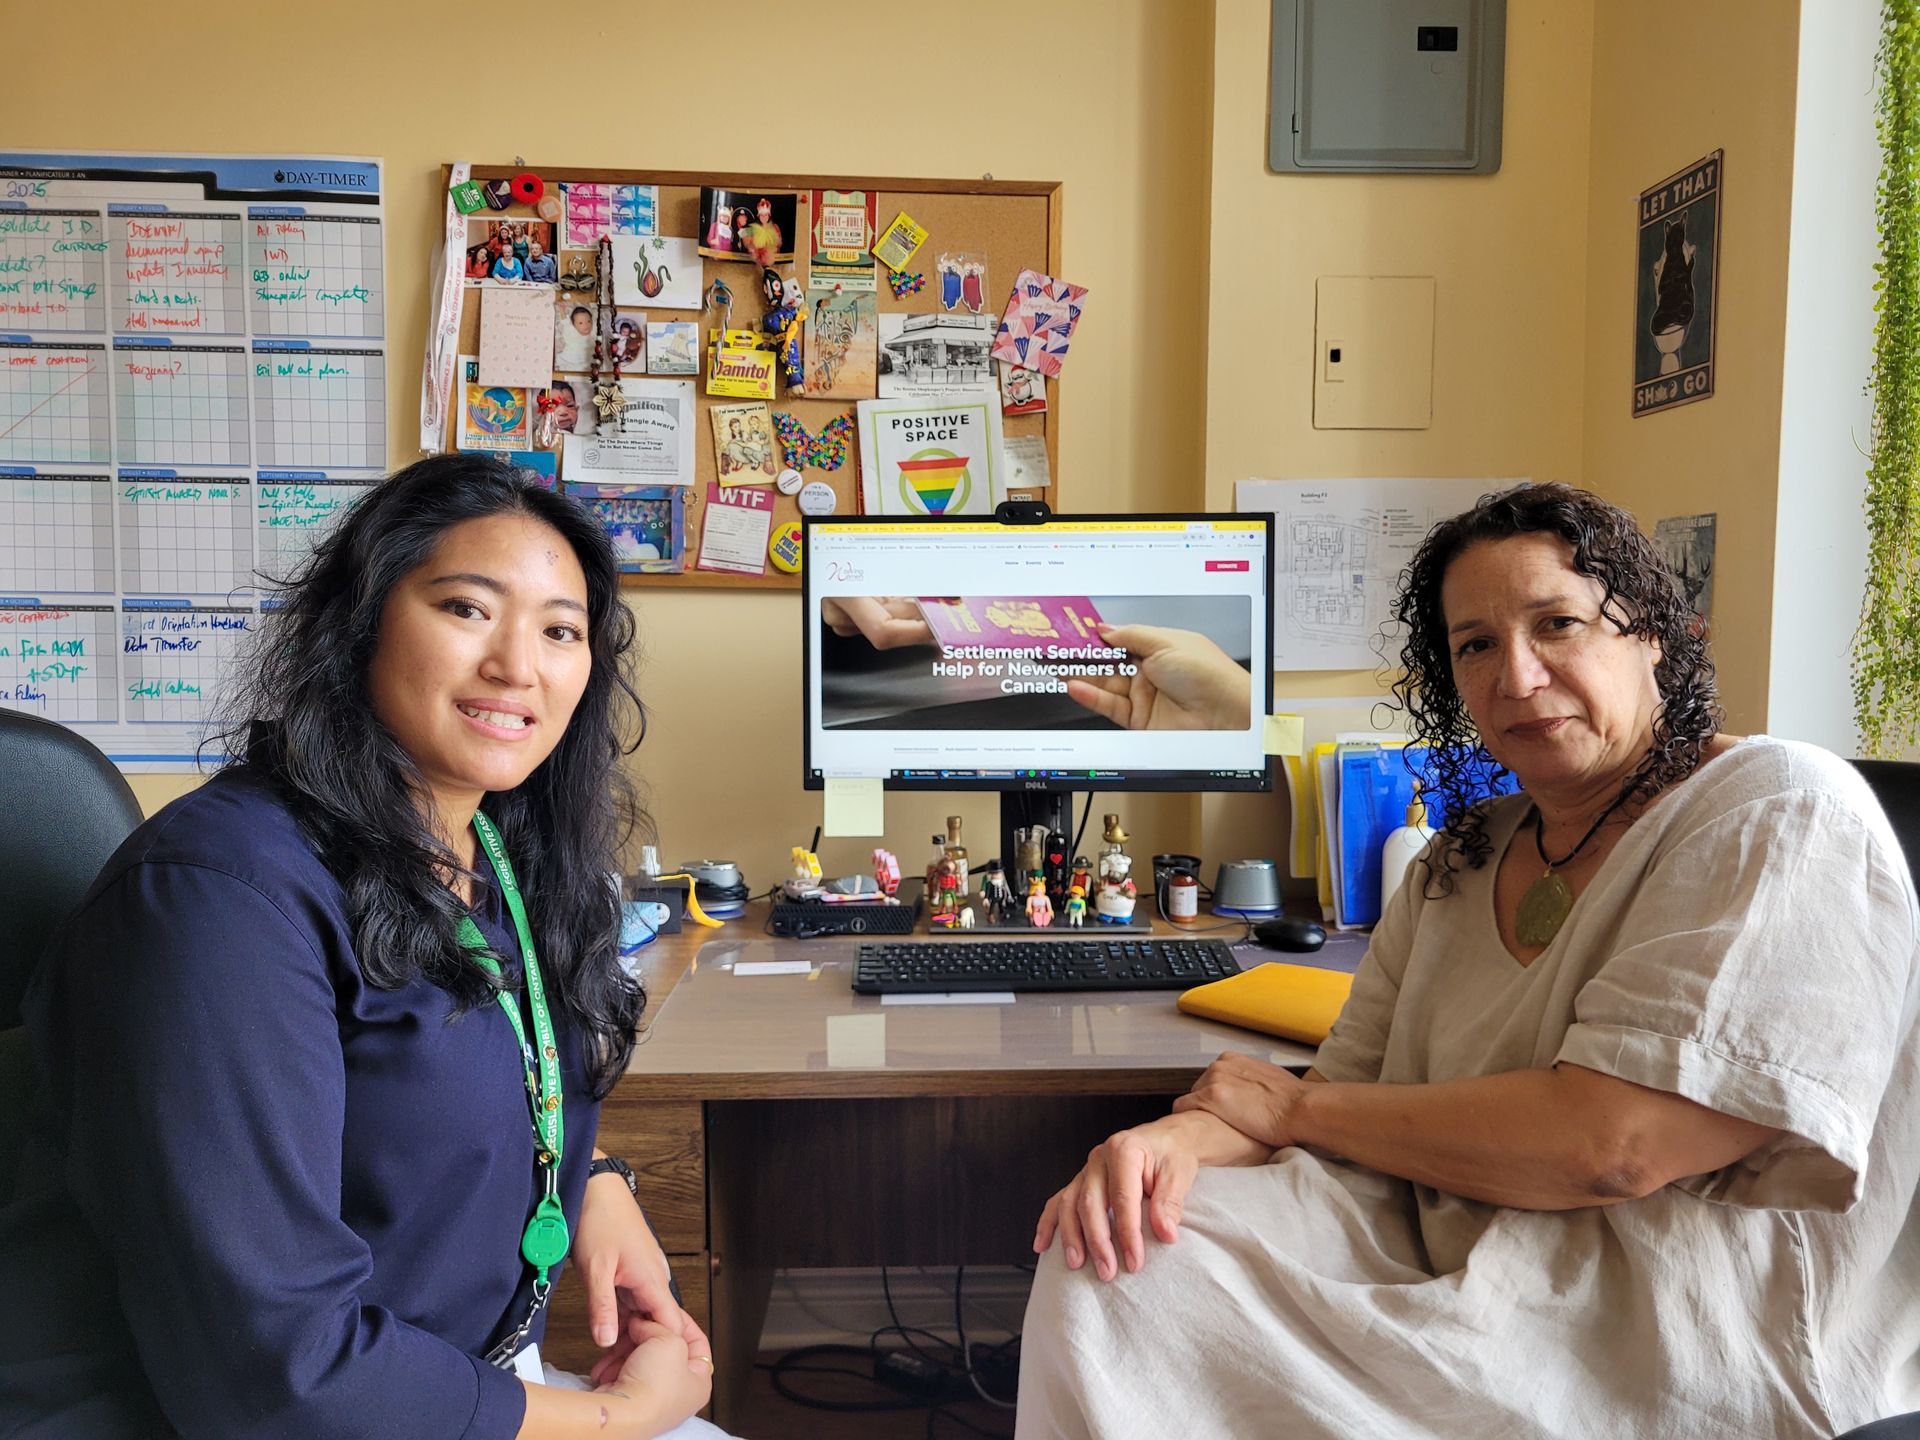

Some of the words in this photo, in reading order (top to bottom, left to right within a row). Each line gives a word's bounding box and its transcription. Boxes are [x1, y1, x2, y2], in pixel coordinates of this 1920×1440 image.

[25, 169, 70, 178] PLANIFICATEUR
[286, 171, 368, 187] DAY-TIMER
[7, 180, 51, 198] 2025
[1643, 193, 1667, 219] LET
[1673, 165, 1714, 204] THAT
[829, 250, 858, 260] VENUE
[1684, 371, 1706, 395] GO
[621, 417, 650, 426] riangle
[651, 418, 675, 431] Award
[892, 414, 970, 430] POSITIVE
[905, 429, 959, 442] SPACE
[718, 488, 766, 507] WTF
[779, 535, 800, 555] PUBLIC
[773, 543, 799, 567] SCHOOLS
[943, 645, 1041, 660] Settlement
[1047, 644, 1127, 660] Services:
[932, 661, 974, 678] Help
[977, 662, 1003, 677] for
[1008, 663, 1114, 677] Newcomers
[1119, 664, 1138, 677] to
[1000, 679, 1069, 694] Canada
[1025, 781, 1047, 789] DELL
[484, 831, 515, 891] LEGISLATIVE
[527, 950, 542, 1001] ONTARIO
[535, 1003, 545, 1020] OF
